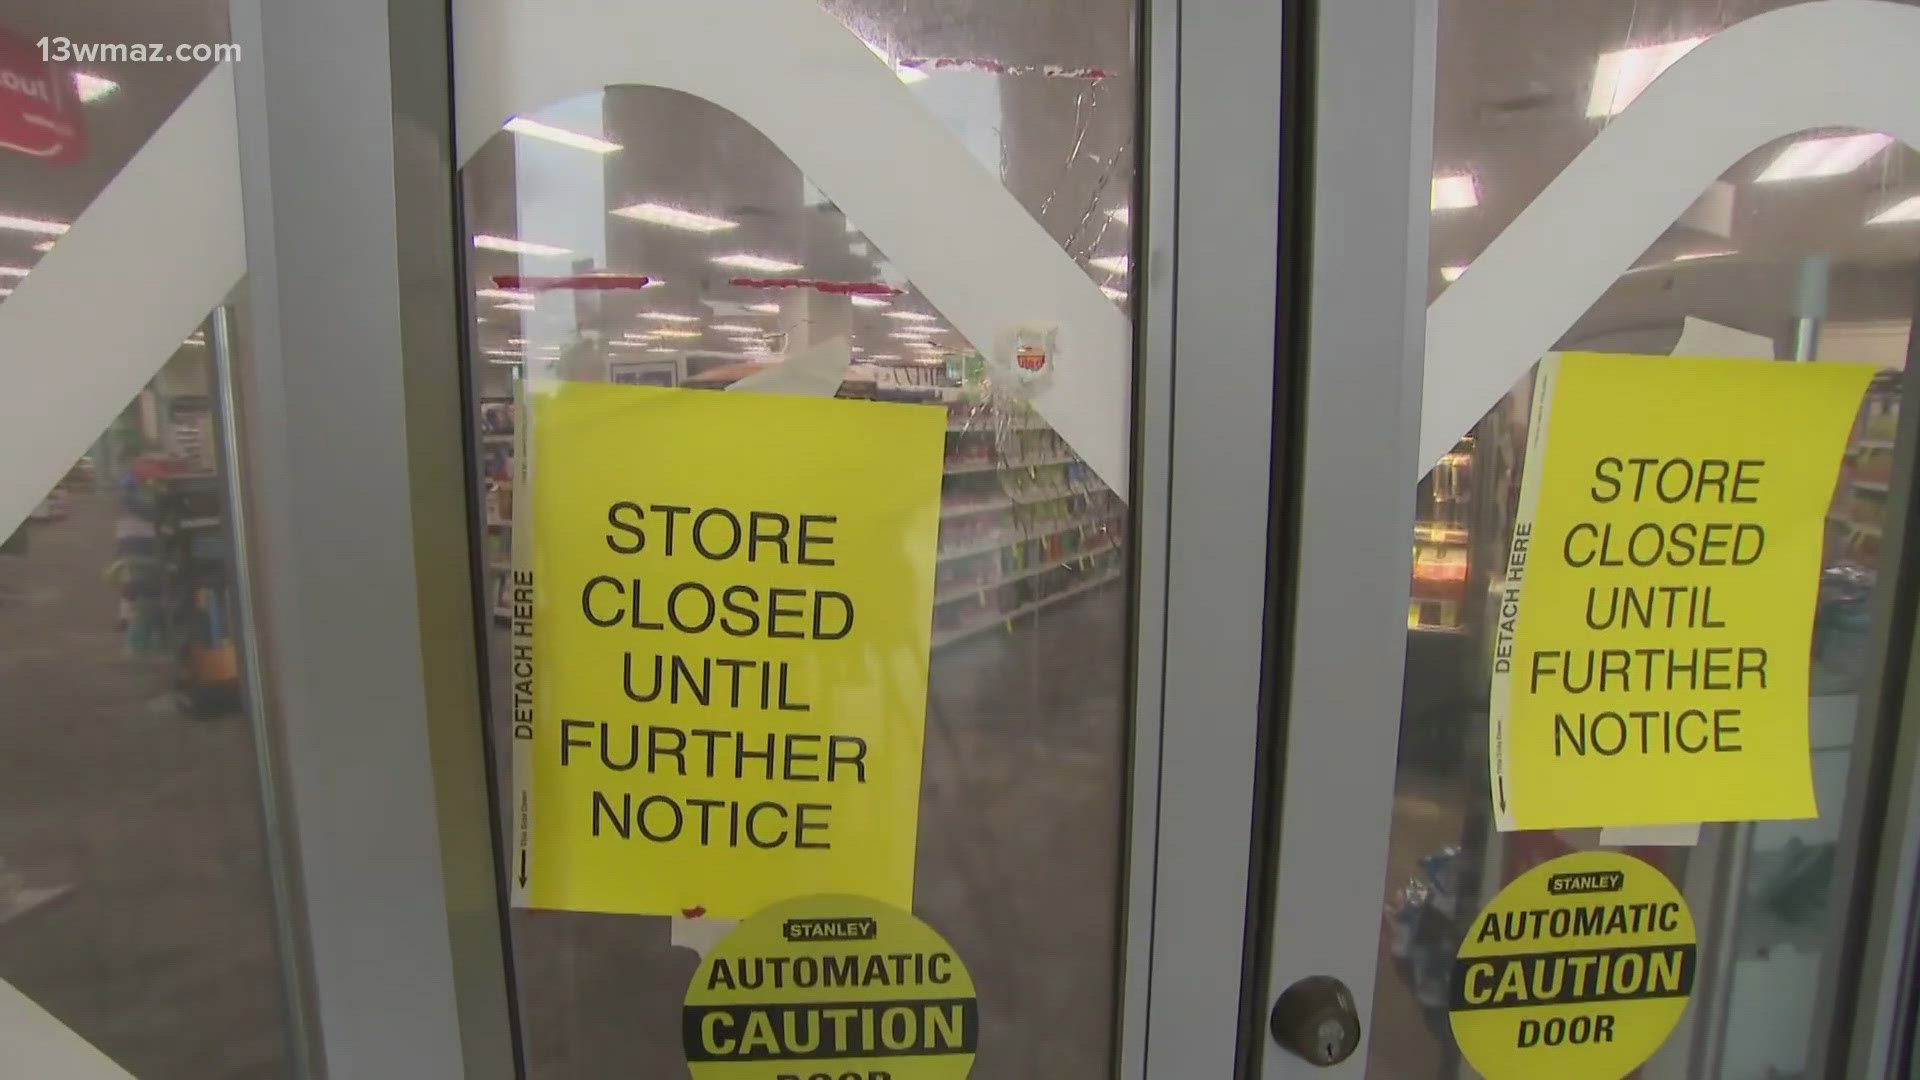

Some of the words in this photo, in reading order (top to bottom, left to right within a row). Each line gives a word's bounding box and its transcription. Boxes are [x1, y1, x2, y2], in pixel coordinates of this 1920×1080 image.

[0, 69, 48, 100] out
[1592, 457, 1765, 504] STORE
[606, 502, 837, 566] STORE
[1564, 523, 1764, 568] CLOSED
[514, 571, 532, 637] HERE
[582, 576, 854, 640] CLOSED
[1495, 589, 1520, 673] DETACH
[1508, 522, 1532, 582] HERE
[1586, 587, 1725, 630] UNTIL
[515, 645, 532, 739] DETACH
[624, 652, 809, 711] UNTIL
[1531, 648, 1767, 694] FURTHER
[561, 719, 866, 782] FURTHER
[1555, 710, 1742, 756] NOTICE
[593, 791, 832, 849] NOTICE
[1553, 875, 1620, 891] STANLEY
[790, 921, 872, 938] STANLEY
[1477, 902, 1680, 943] AUTOMATIC
[707, 953, 951, 990] AUTOMATIC
[1463, 950, 1683, 1004] CAUTION
[701, 1005, 964, 1055] CAUTION
[1518, 1015, 1614, 1048] DOOR
